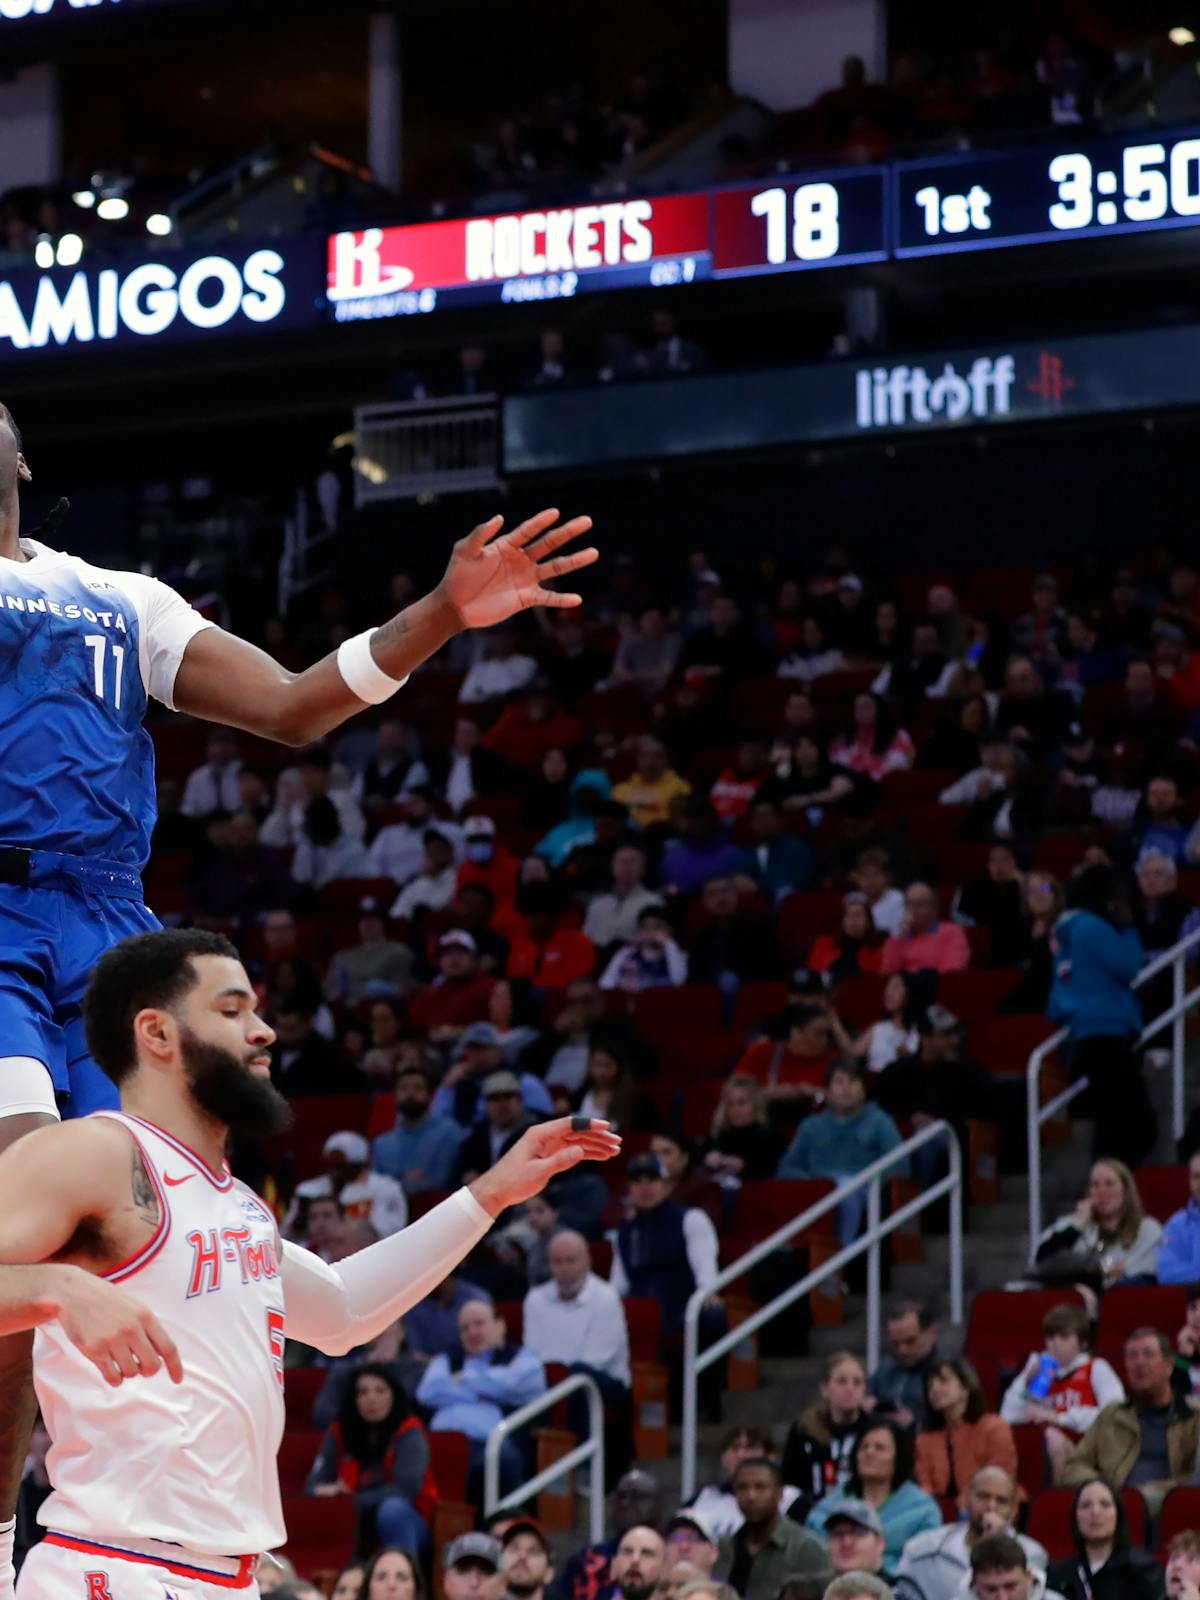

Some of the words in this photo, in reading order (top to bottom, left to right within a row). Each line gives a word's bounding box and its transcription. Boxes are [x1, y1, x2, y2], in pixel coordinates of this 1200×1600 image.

[465, 200, 653, 282] ROCKETS
[751, 182, 839, 261] 18
[915, 184, 992, 236] 1st
